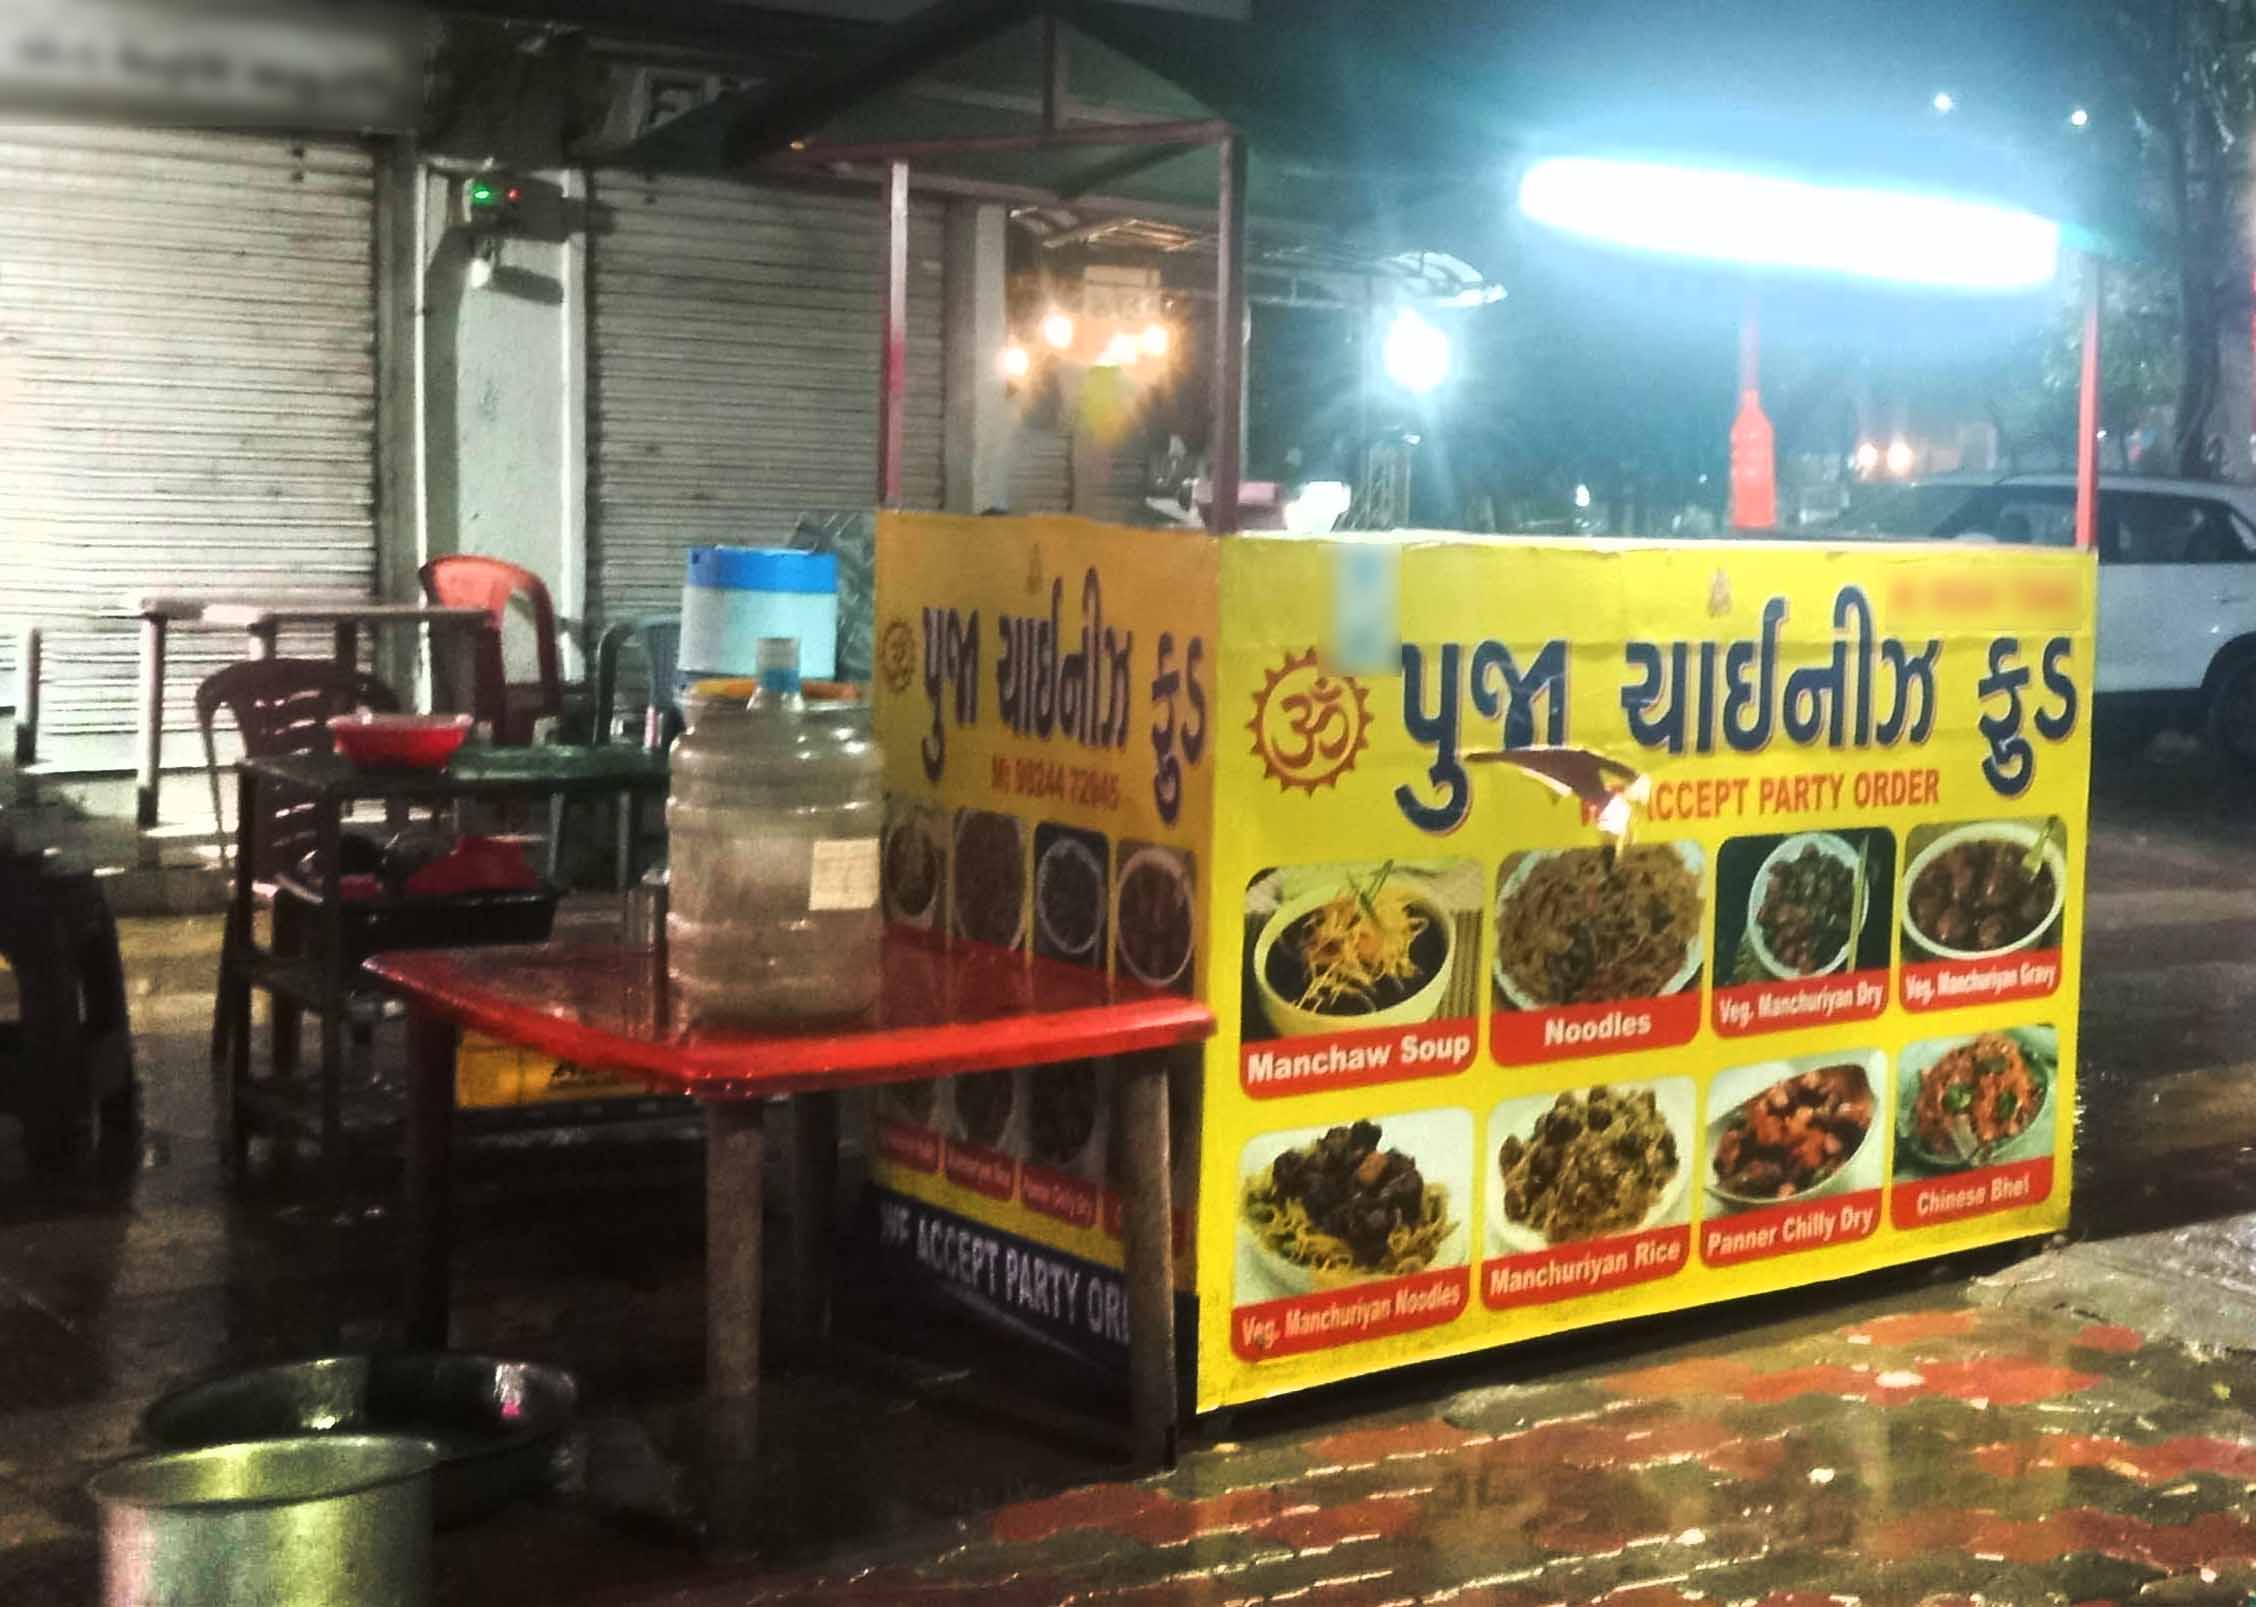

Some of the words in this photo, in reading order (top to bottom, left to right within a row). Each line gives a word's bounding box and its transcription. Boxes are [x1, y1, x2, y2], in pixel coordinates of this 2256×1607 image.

[1621, 585, 1941, 755] ચાઈનીઝ
[1759, 773, 1844, 815] PARTY
[1854, 768, 1940, 808] ORDER
[1758, 985, 1854, 1018] Manchuriyan
[1856, 980, 1883, 1012] Dry
[1544, 1010, 1652, 1048] Noodles
[1247, 1042, 1393, 1087] Manchaw
[1400, 1033, 1471, 1064] Soup
[1917, 1185, 1986, 1217] Chinese
[1707, 1226, 1778, 1258] Panner
[1782, 1209, 1836, 1242] Chilly
[1840, 1205, 1873, 1235] Dry
[917, 1217, 1000, 1294] ACCEPT
[1005, 1248, 1080, 1325] PARTY
[1490, 1252, 1629, 1296] Manchuriyan
[1634, 1240, 1681, 1270] Rice
[1284, 1299, 1392, 1338] Manchuriyan
[1395, 1281, 1461, 1316] Noodles
